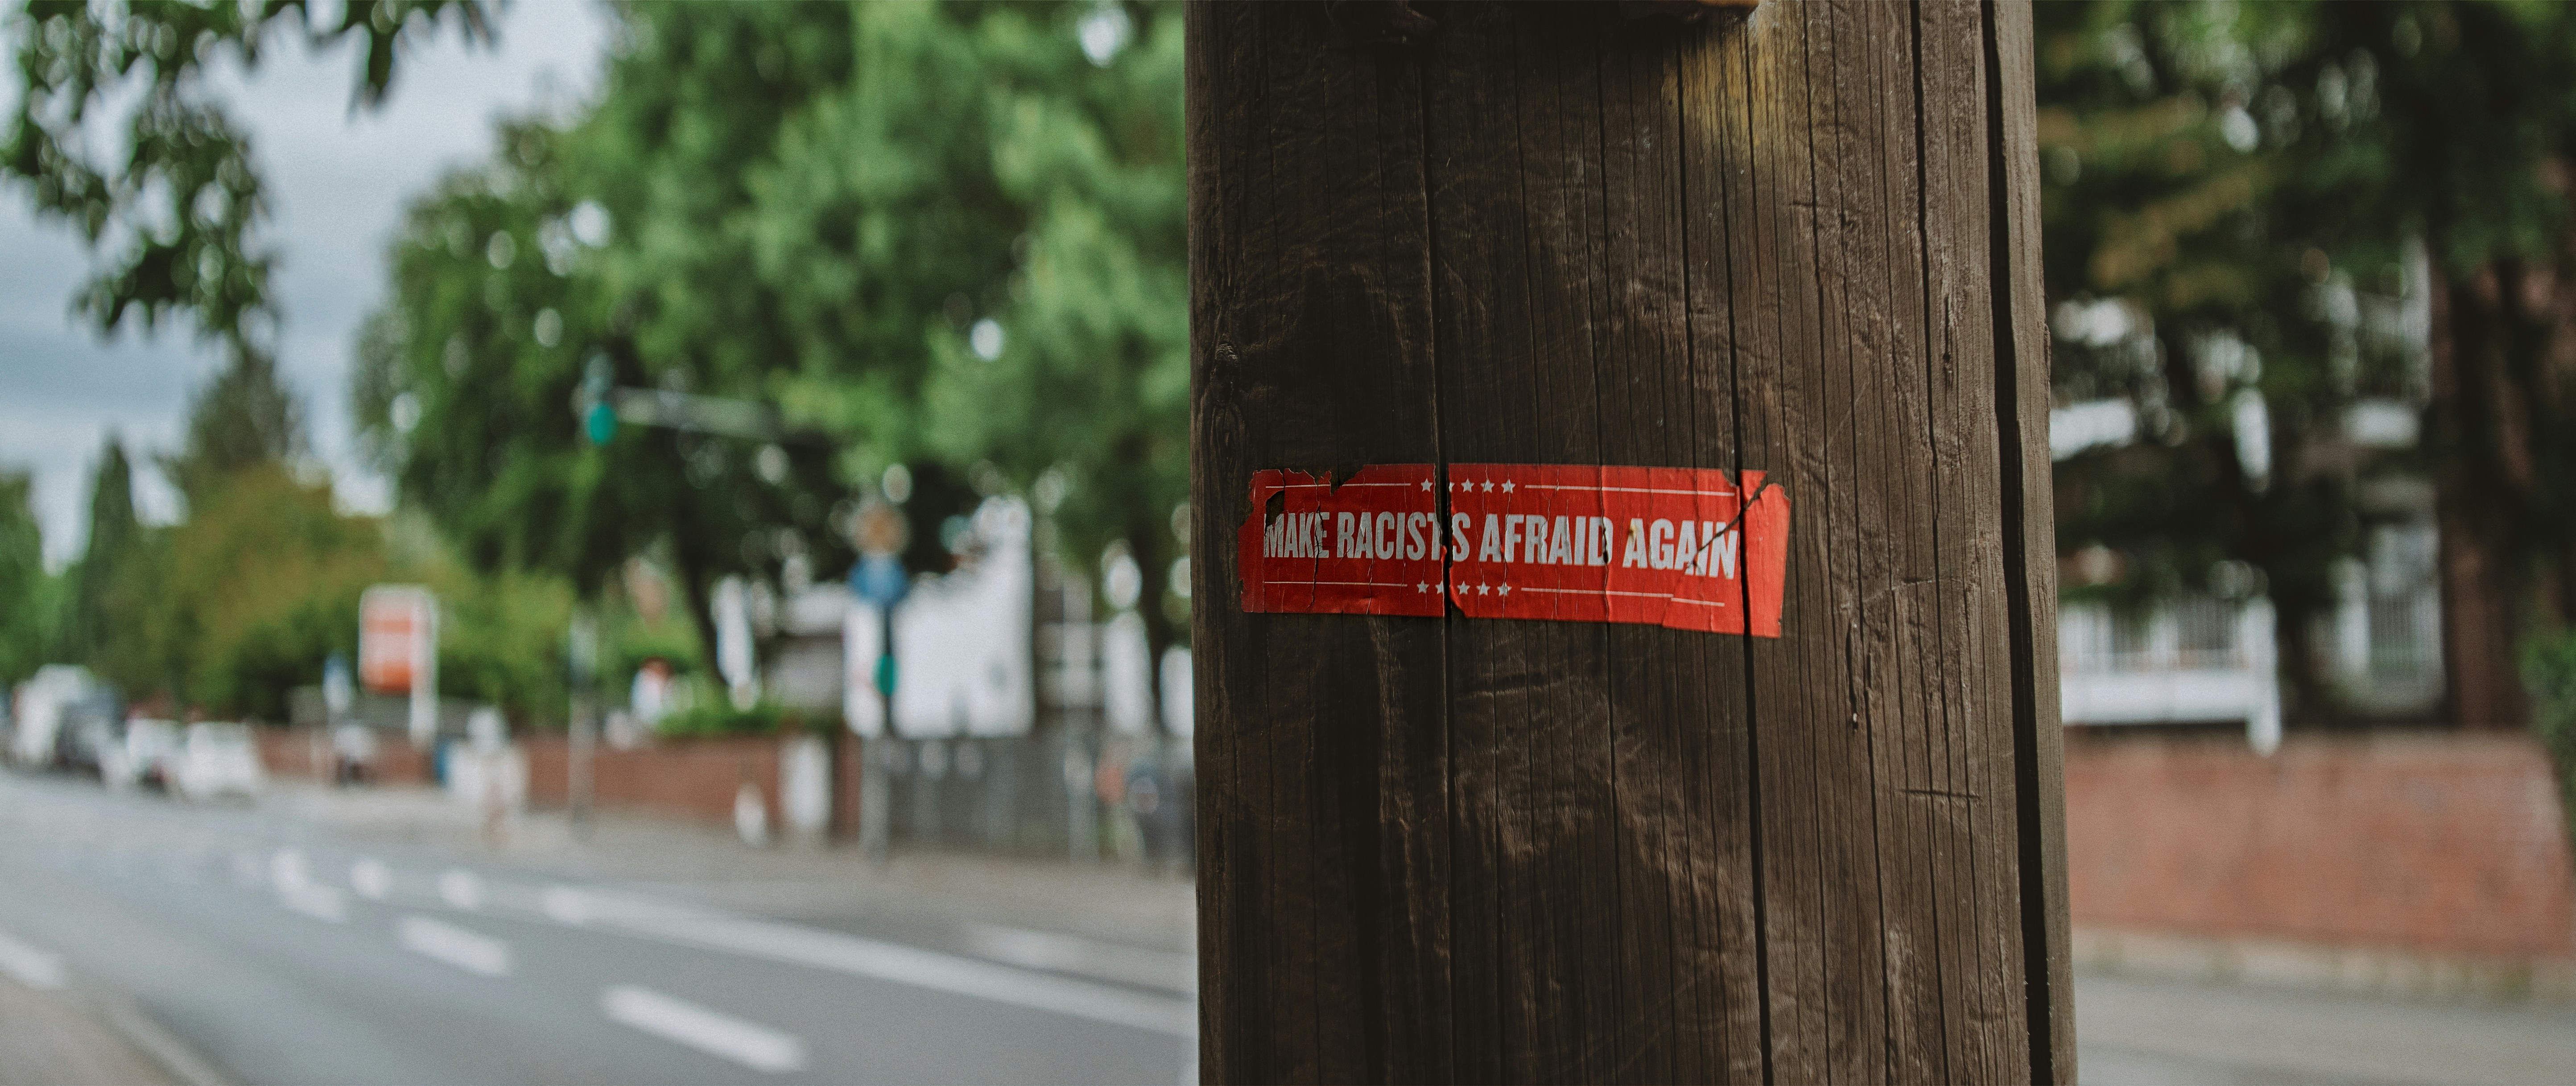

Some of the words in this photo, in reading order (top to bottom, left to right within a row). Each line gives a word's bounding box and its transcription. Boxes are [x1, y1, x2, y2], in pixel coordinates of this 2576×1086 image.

[1264, 512, 1329, 558] MAKE
[1338, 512, 1471, 562] RACISTS
[1479, 514, 1614, 566] AFRAID
[1623, 518, 1738, 580] AGAIN
